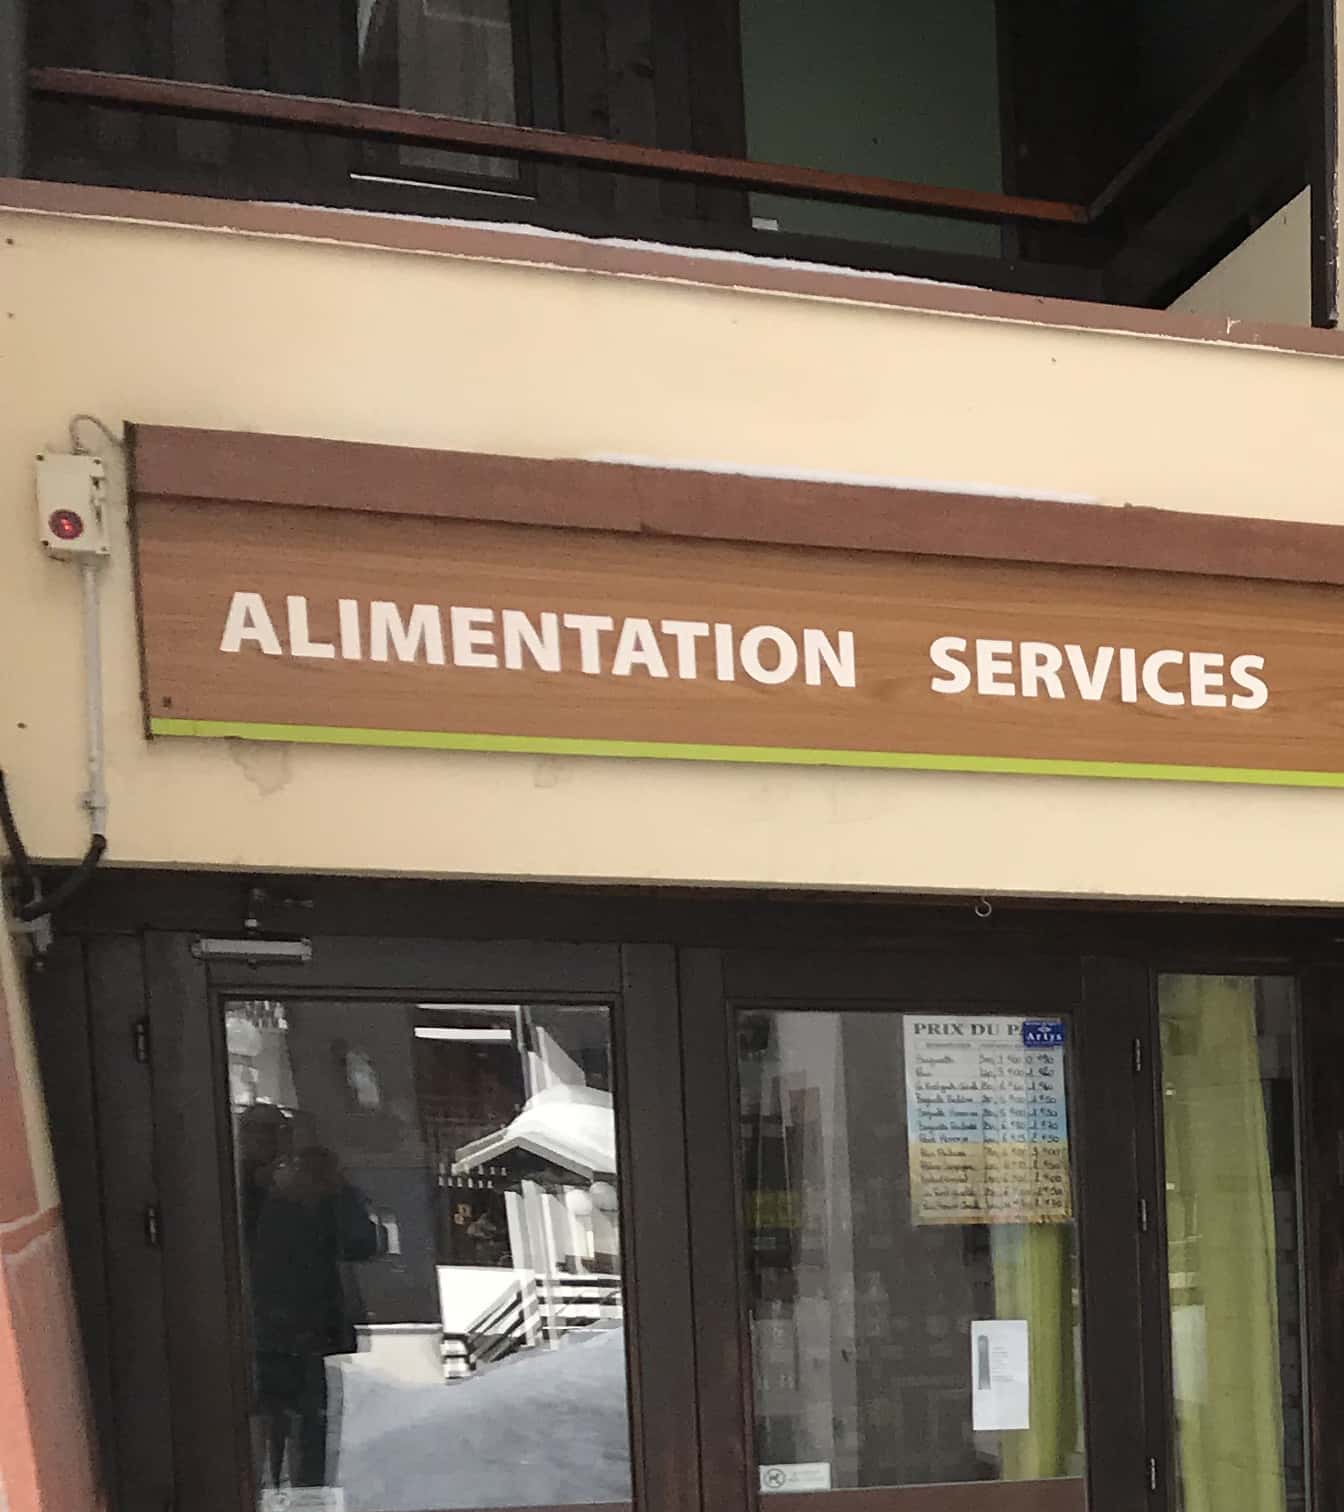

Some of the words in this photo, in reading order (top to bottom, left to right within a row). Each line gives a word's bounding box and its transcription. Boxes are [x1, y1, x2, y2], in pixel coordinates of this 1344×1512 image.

[219, 592, 857, 689] ALIMENTATION
[929, 636, 1269, 710] SERVICES
[913, 1022, 965, 1036] PRIX
[971, 1023, 1000, 1036] DU
